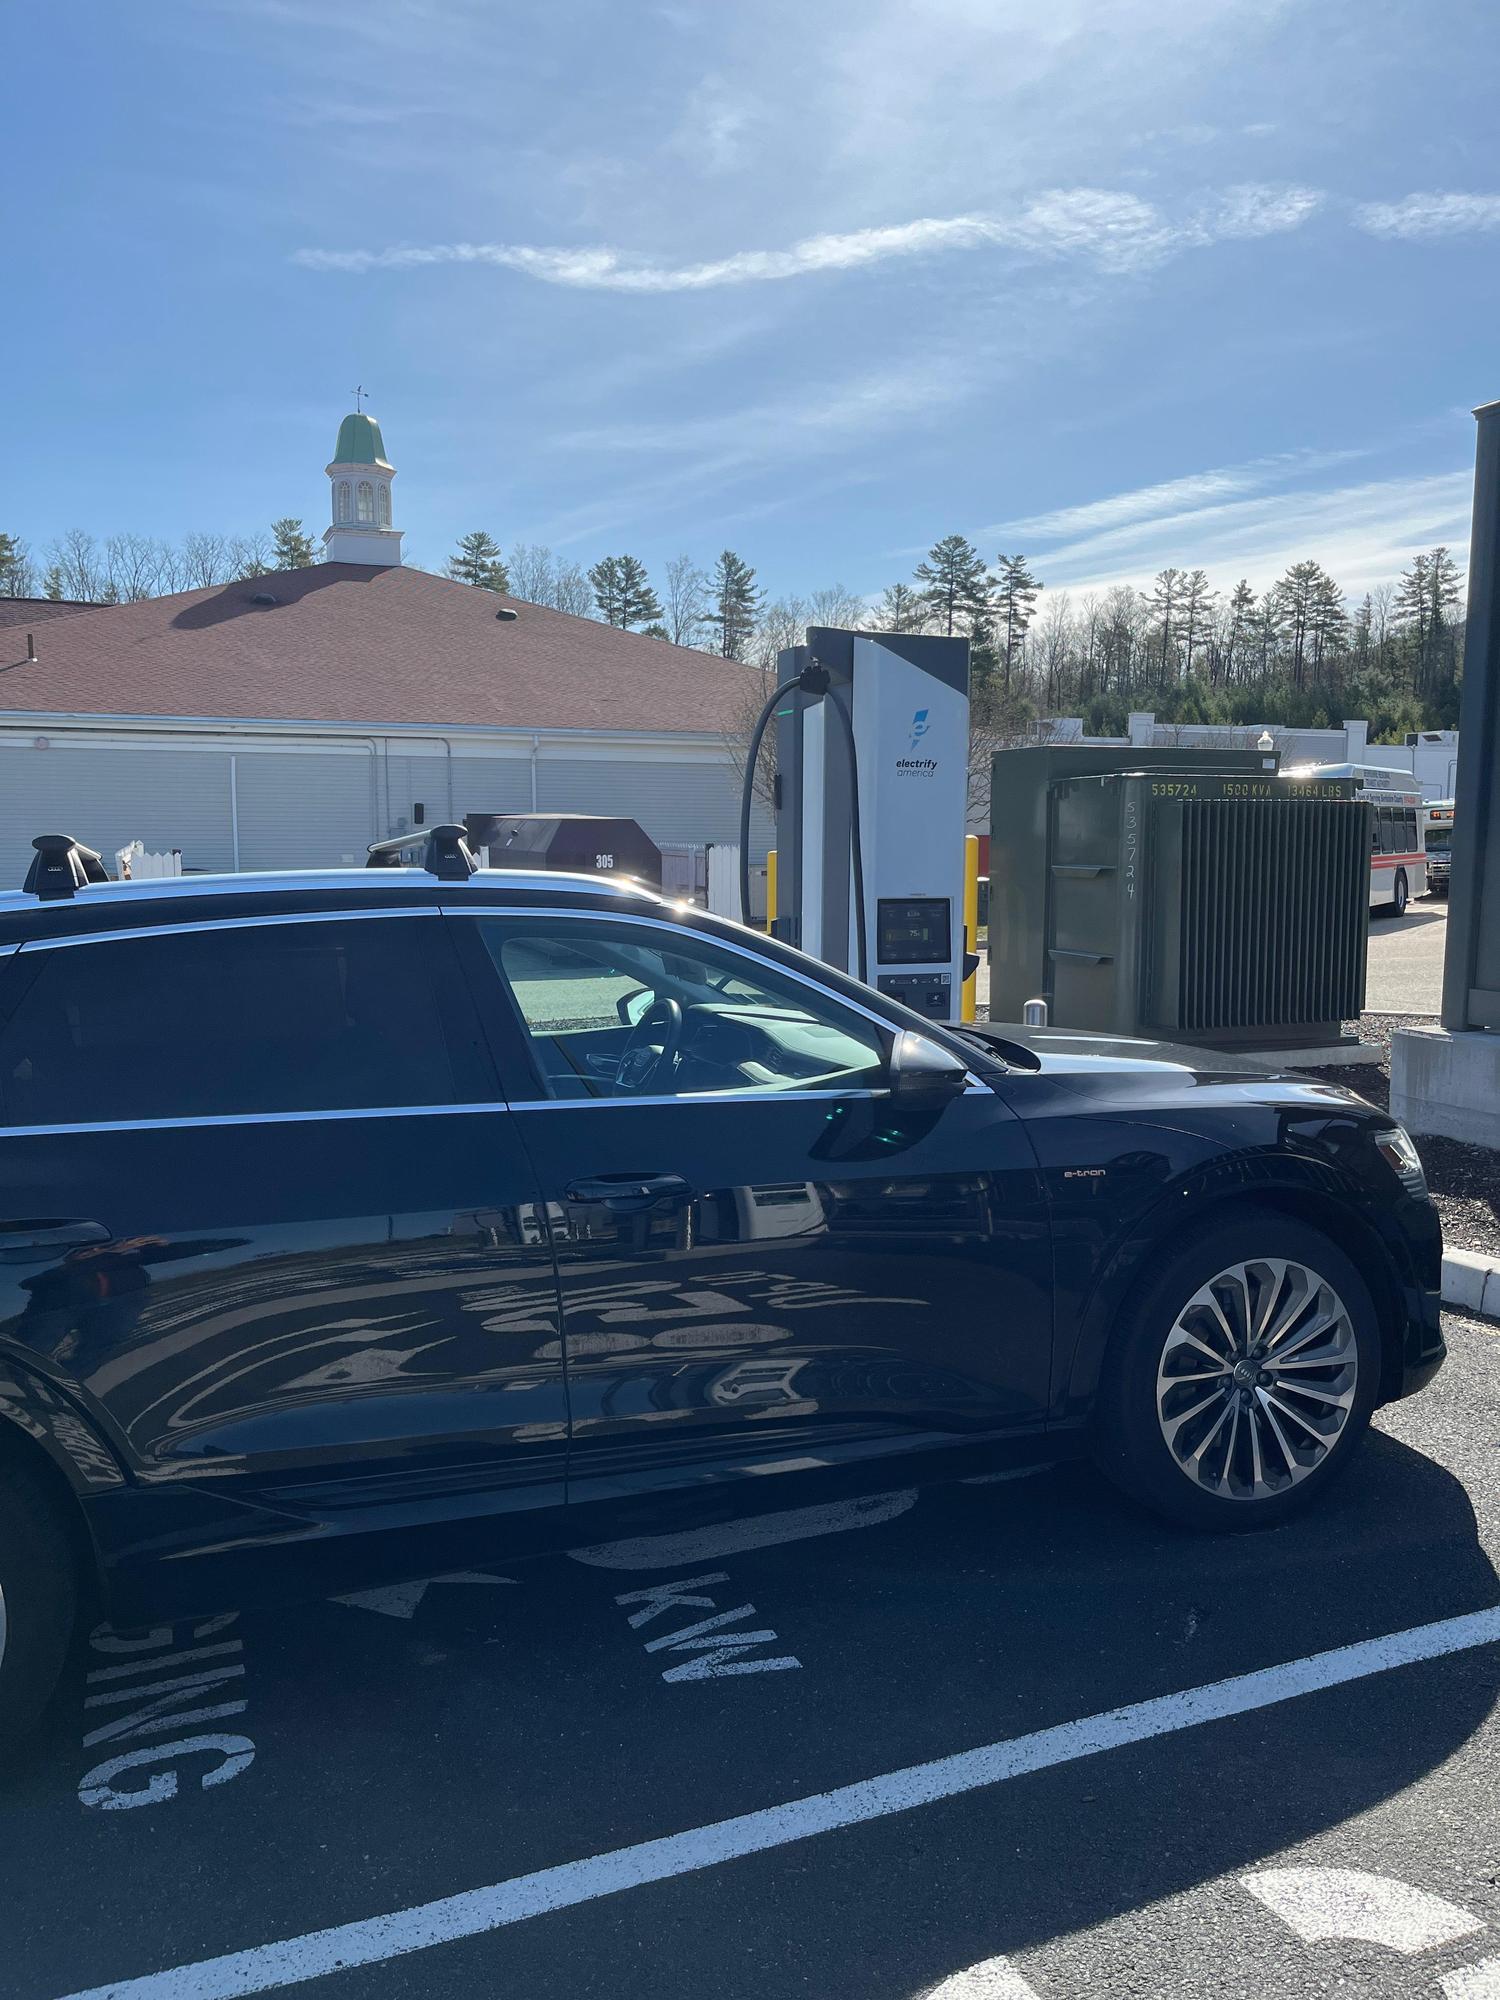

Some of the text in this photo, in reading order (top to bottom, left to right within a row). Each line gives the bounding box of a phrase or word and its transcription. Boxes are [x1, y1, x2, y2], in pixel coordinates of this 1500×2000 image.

[896, 759, 937, 770] electrify
[1152, 784, 1342, 797] 535724 1500 KVA 13464 LBS
[1126, 802, 1137, 900] 535724
[596, 854, 614, 868] 305
[1064, 1169, 1106, 1178] e-tron
